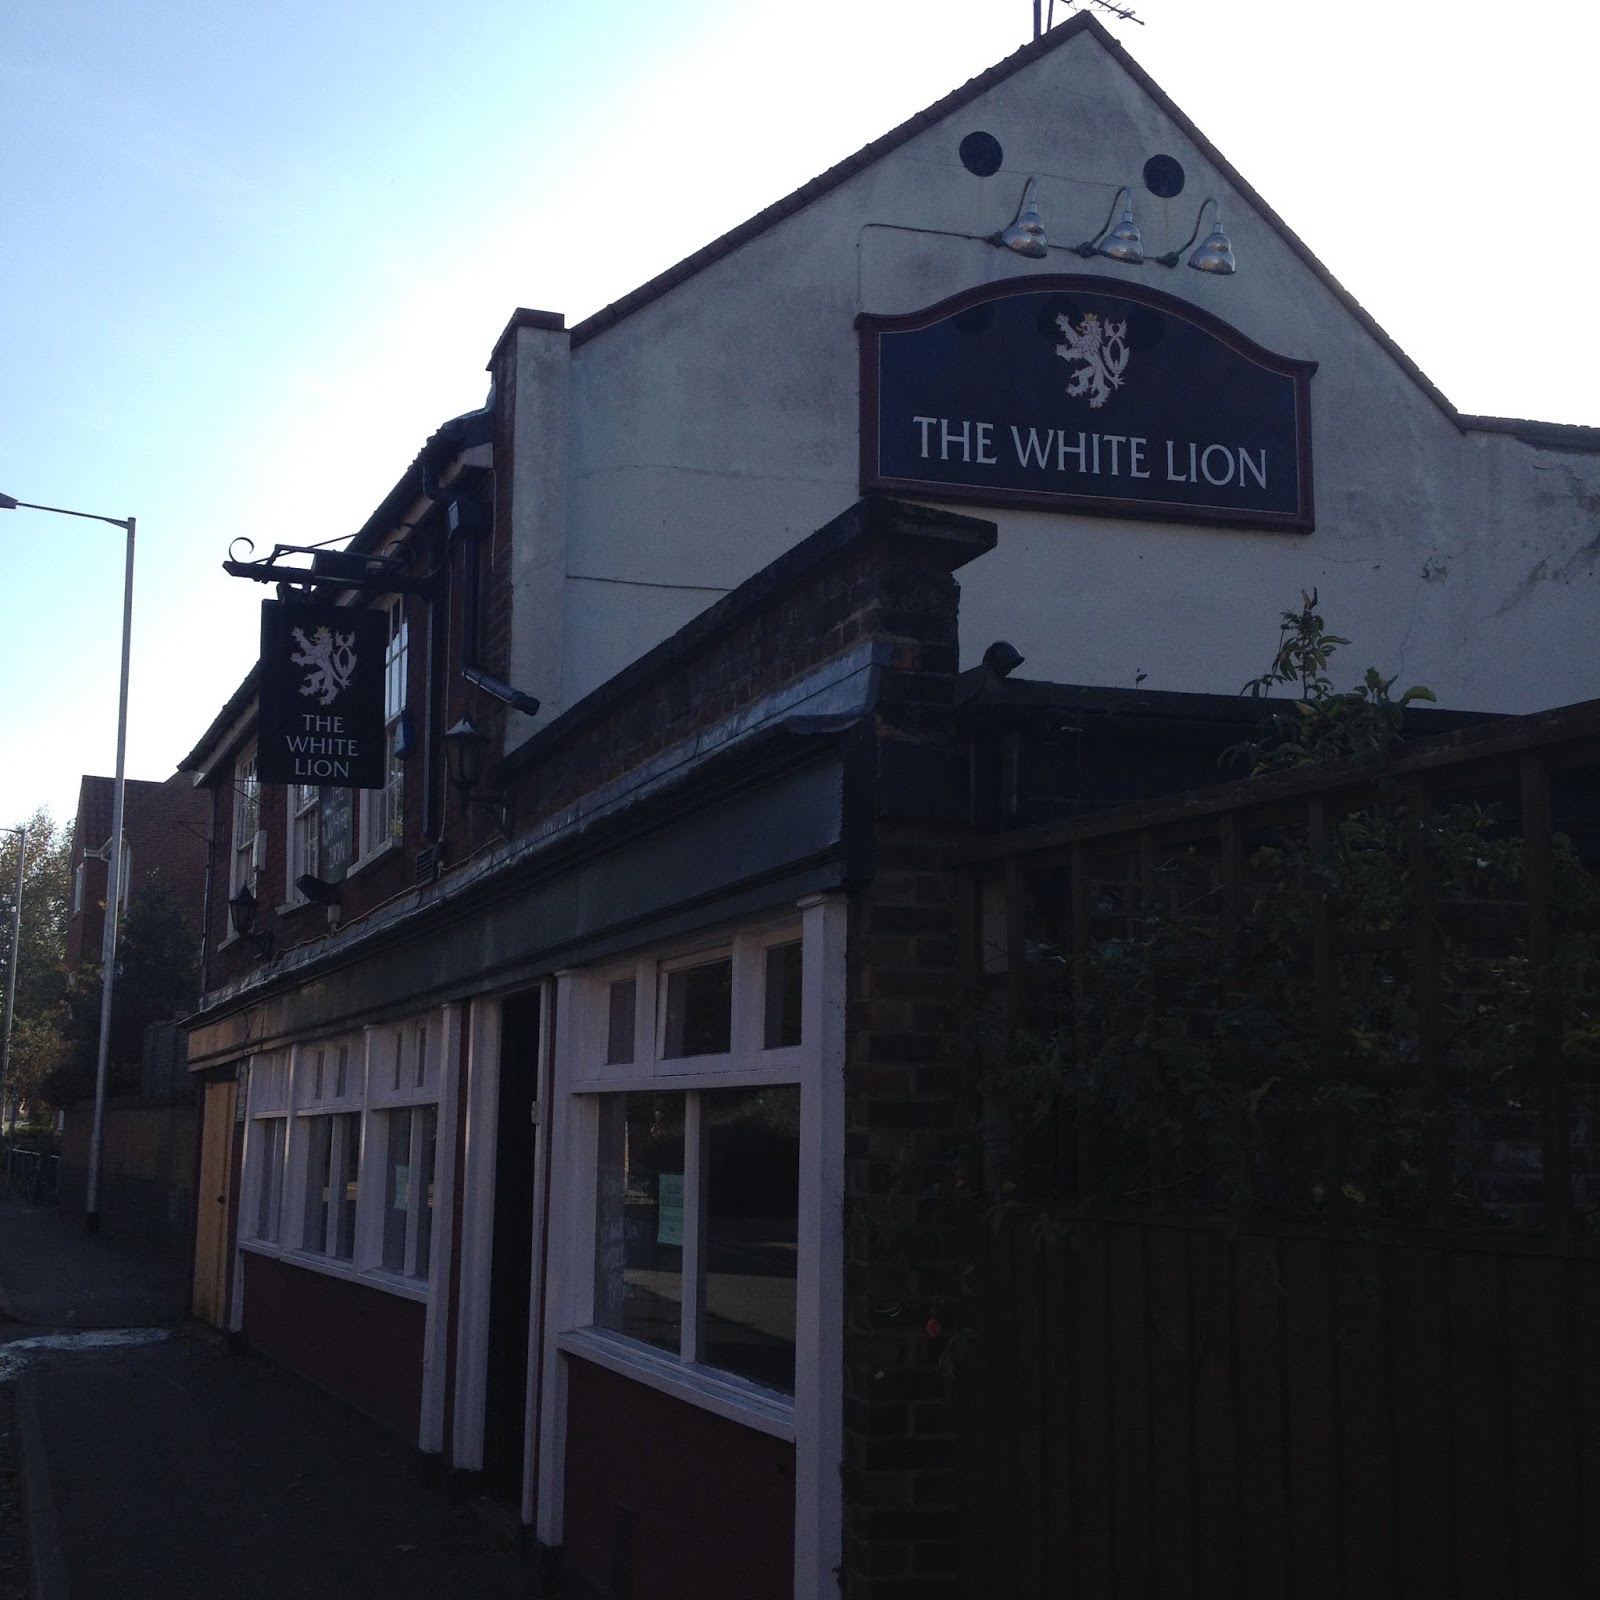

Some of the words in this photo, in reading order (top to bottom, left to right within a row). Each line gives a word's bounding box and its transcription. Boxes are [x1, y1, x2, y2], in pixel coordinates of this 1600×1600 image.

[913, 416, 997, 464] THE
[1010, 425, 1150, 478] WHITE
[1166, 440, 1267, 489] LION
[302, 714, 344, 733] THE
[286, 736, 358, 756] WHITE
[295, 758, 349, 778] LION
